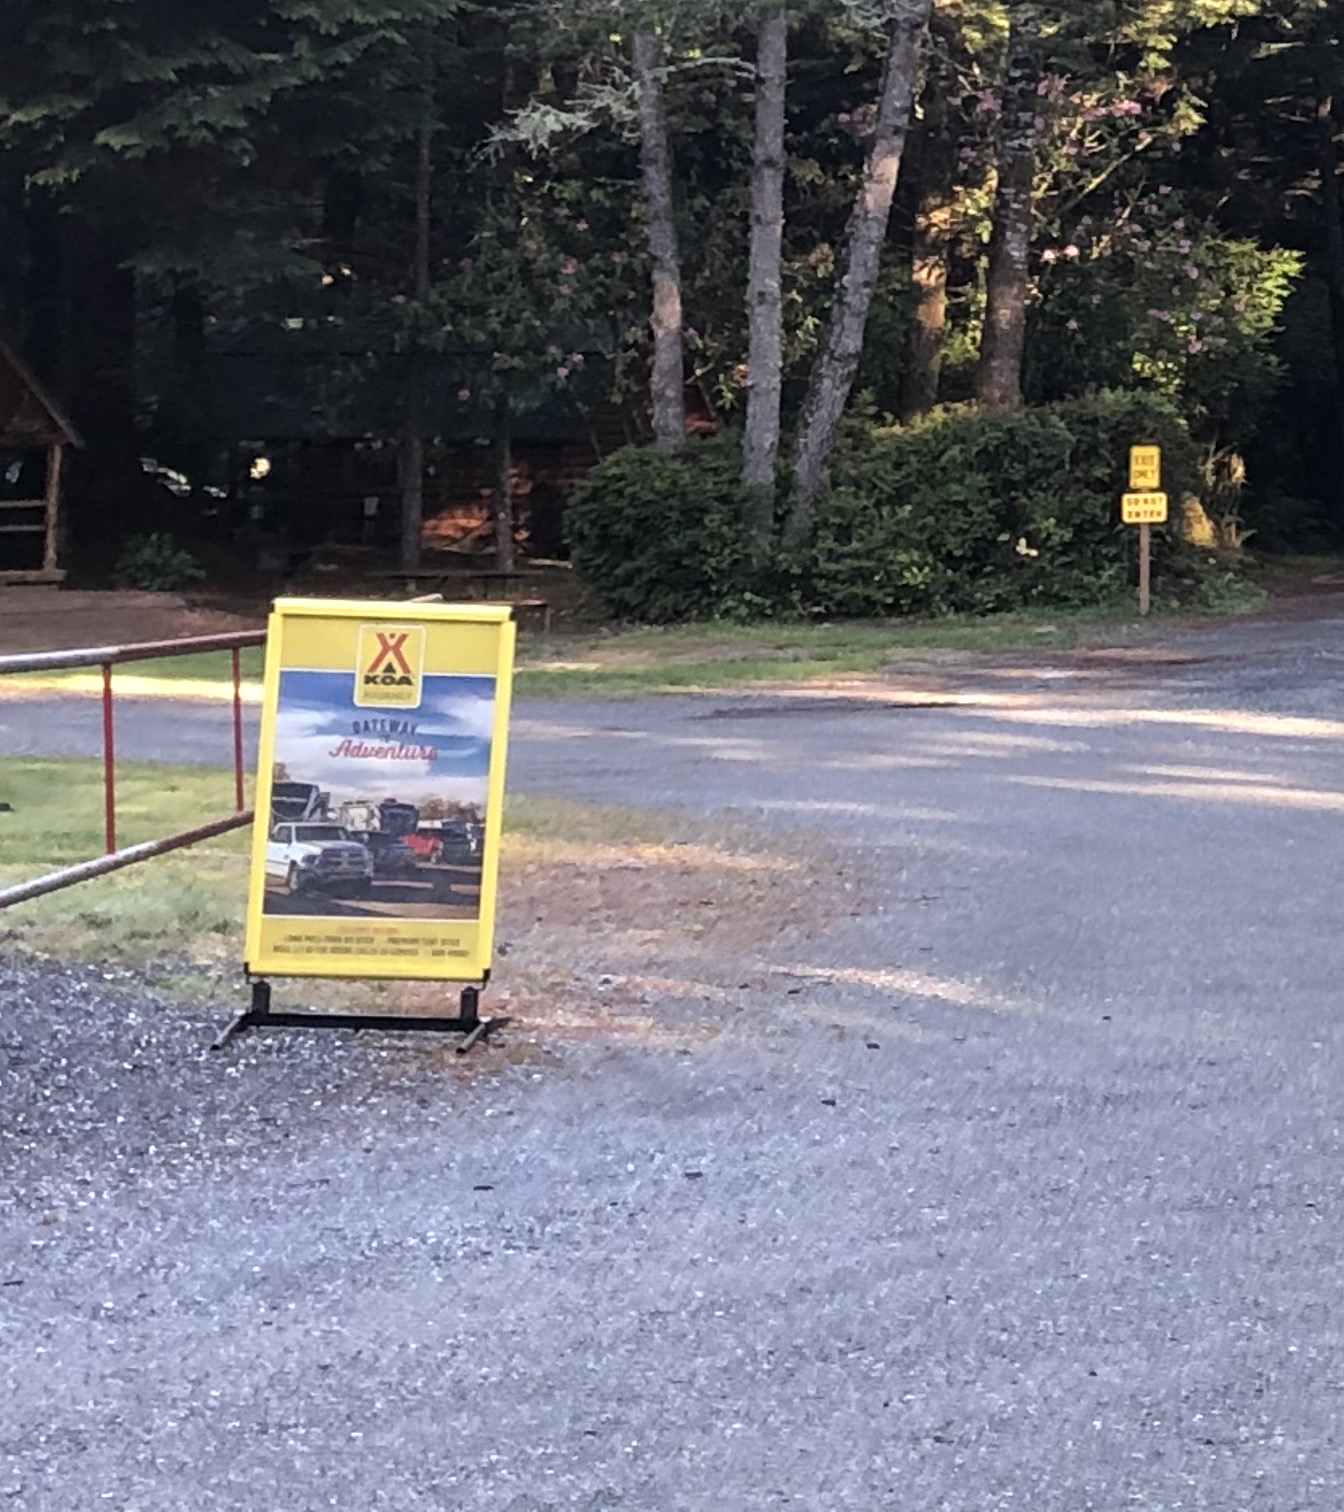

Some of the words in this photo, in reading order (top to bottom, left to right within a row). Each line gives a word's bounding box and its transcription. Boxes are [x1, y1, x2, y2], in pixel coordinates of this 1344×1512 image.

[363, 674, 415, 686] KOA
[352, 718, 417, 736] GATEWAY
[328, 738, 439, 761] Adventure
